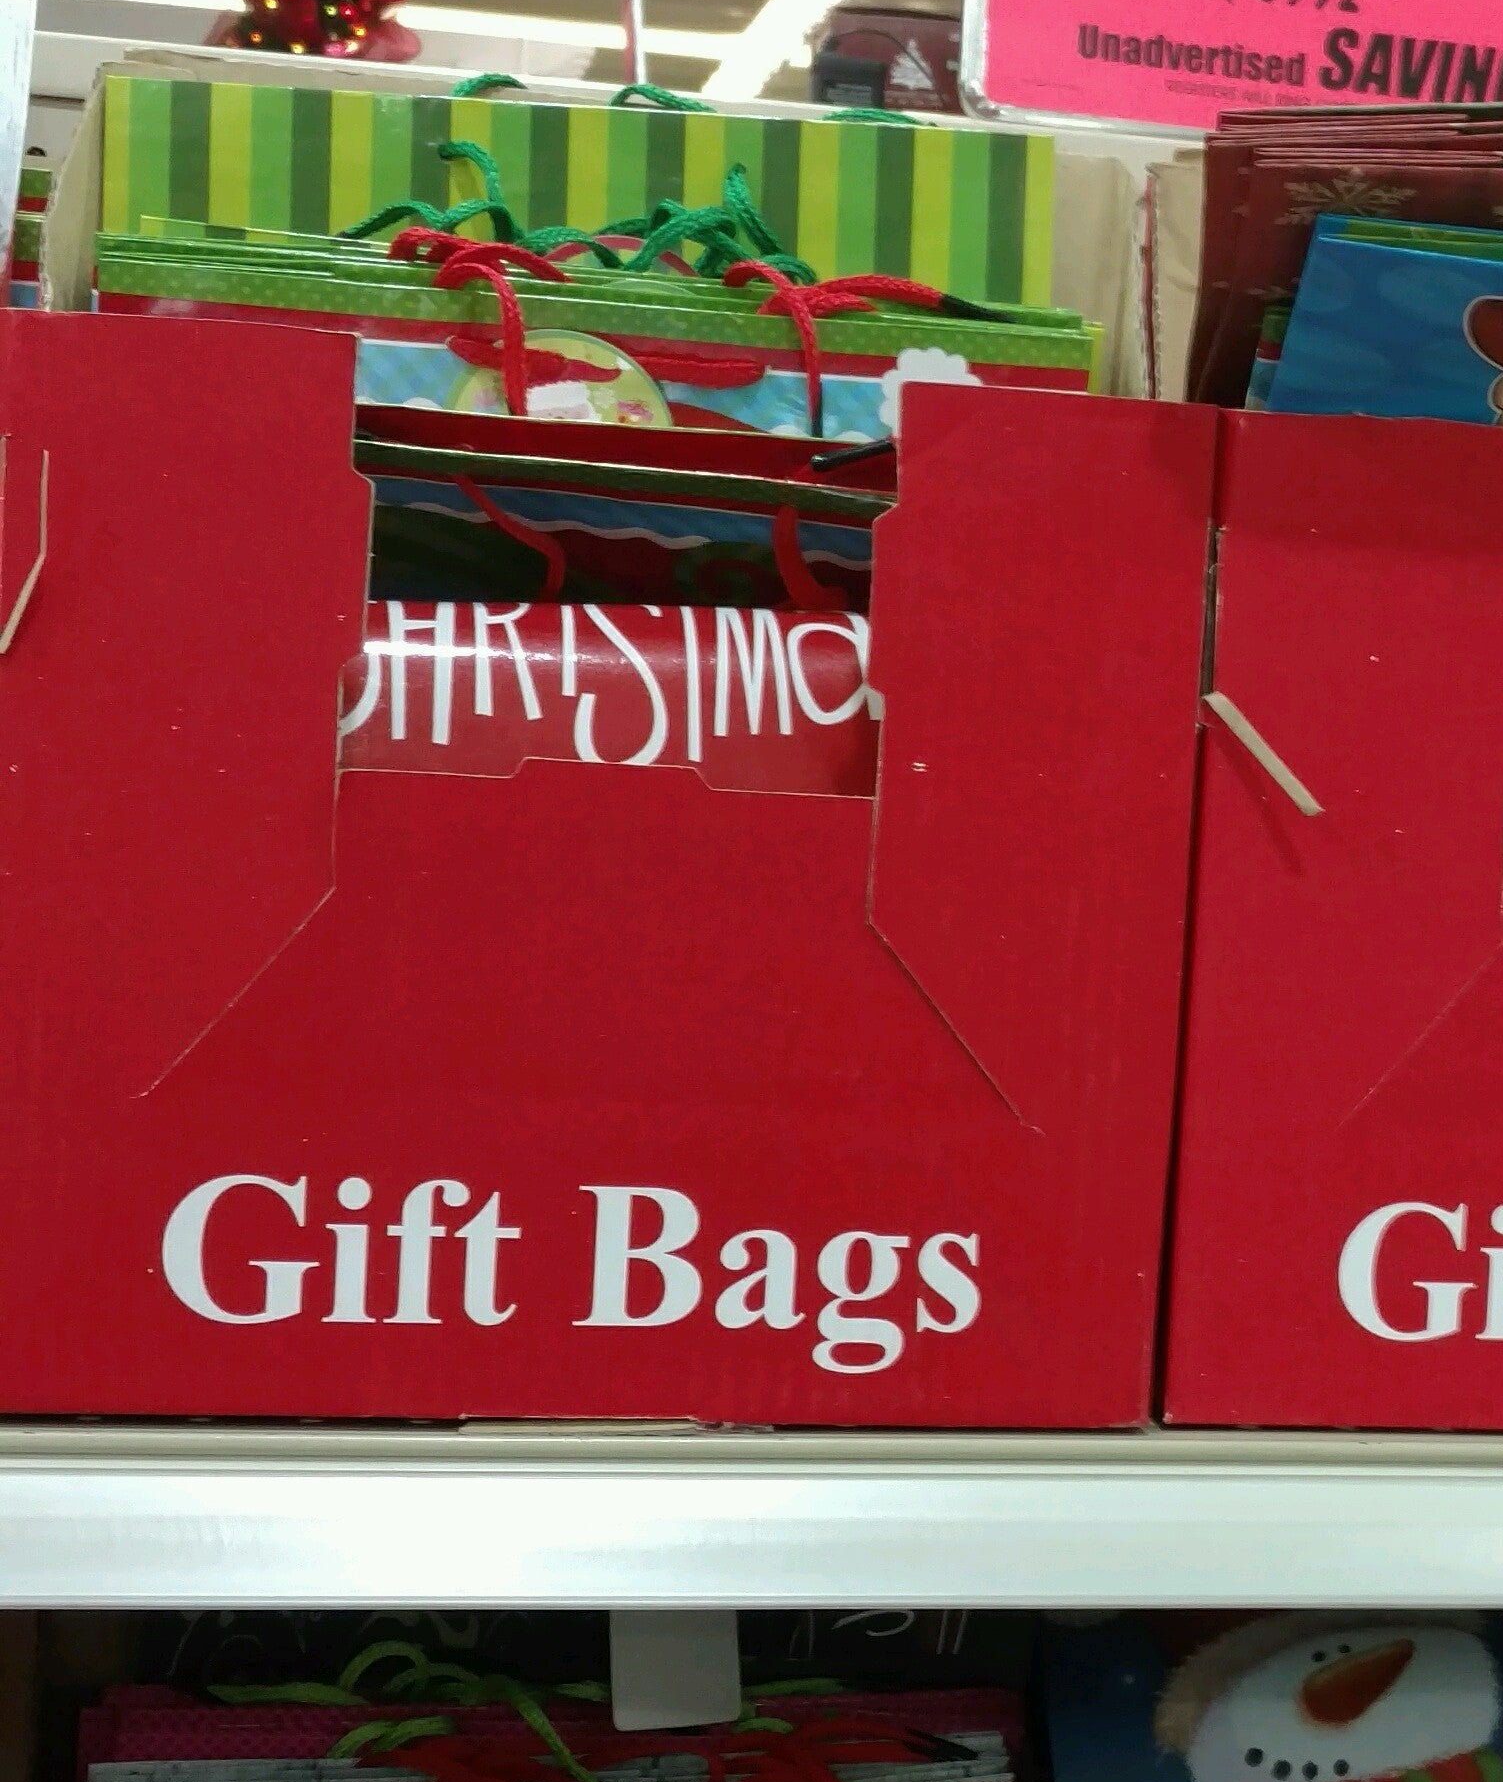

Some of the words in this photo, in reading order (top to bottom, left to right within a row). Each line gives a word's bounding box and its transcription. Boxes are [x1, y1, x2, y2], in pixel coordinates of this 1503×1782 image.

[1077, 23, 1305, 86] Unadvertised
[161, 1174, 521, 1326] Gift
[572, 1185, 981, 1375] Bags
